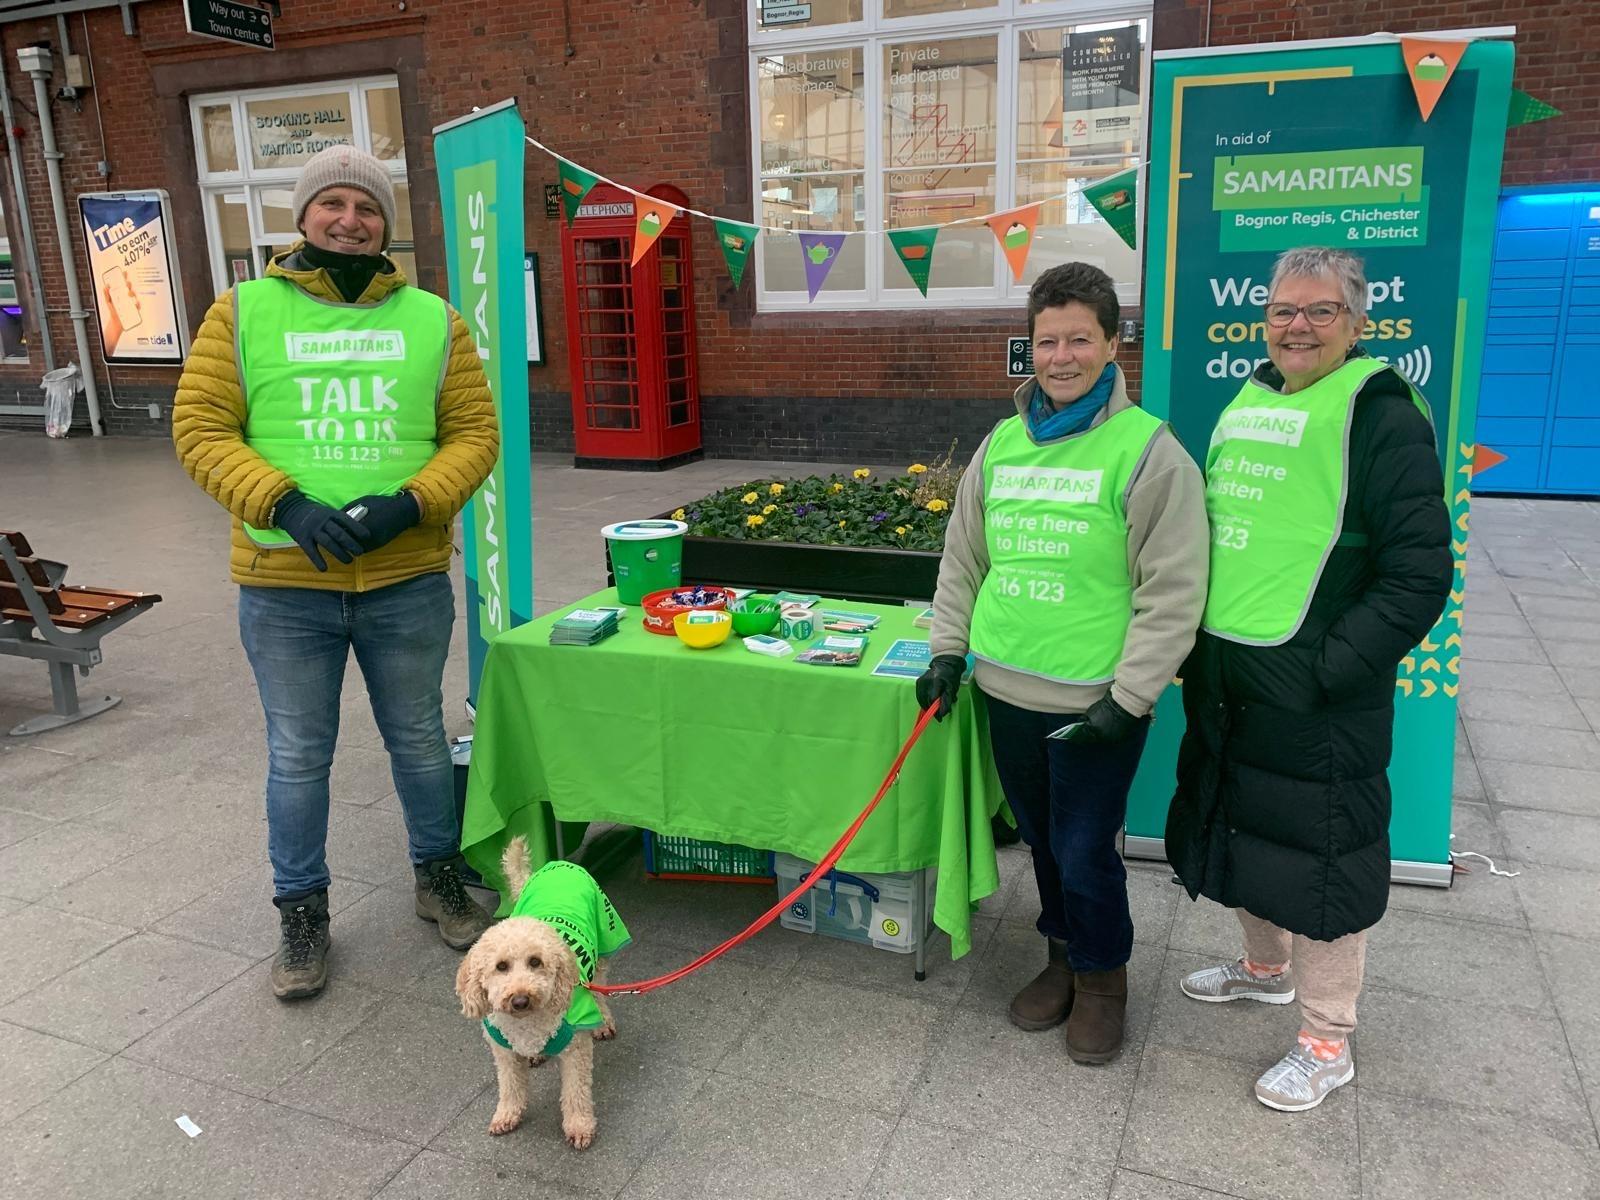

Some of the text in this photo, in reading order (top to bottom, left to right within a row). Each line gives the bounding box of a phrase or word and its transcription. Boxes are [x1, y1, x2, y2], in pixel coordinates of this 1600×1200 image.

[209, 0, 245, 20] Way out
[208, 19, 260, 42] Town centre
[890, 46, 940, 63] Private
[1072, 45, 1117, 57] COMME
[1072, 52, 1131, 66] CANCELLED
[890, 65, 960, 86] dedicated
[1072, 68, 1090, 76] WORK
[1090, 66, 1108, 74] FROM
[1106, 79, 1122, 87] ONLY
[255, 109, 346, 129] BOOKING HALL
[290, 129, 313, 138] AND
[1215, 131, 1271, 147] In aid of
[259, 142, 304, 157] WAITING
[1223, 163, 1413, 195] SAMARITANS
[576, 204, 632, 217] ELEPHONE
[1235, 208, 1420, 229] Bognor Regis, Chichester
[93, 217, 136, 249] Time
[117, 230, 150, 255] to earn
[1347, 225, 1419, 240] & District
[124, 242, 151, 267] 4.07%
[1209, 277, 1268, 307] We
[150, 335, 167, 345] tide
[300, 339, 394, 354] SAMARITANS
[293, 375, 399, 414] TALK
[468, 190, 501, 633] SAMTANS
[295, 417, 345, 442] TO
[312, 445, 344, 461] 116
[349, 446, 381, 462] 123
[1238, 455, 1288, 481] here
[994, 474, 1096, 493] SAMARITANS
[989, 511, 1090, 535] We're here
[995, 534, 1070, 556] to listen
[1215, 525, 1249, 551] 123
[995, 576, 1065, 603] 16 123
